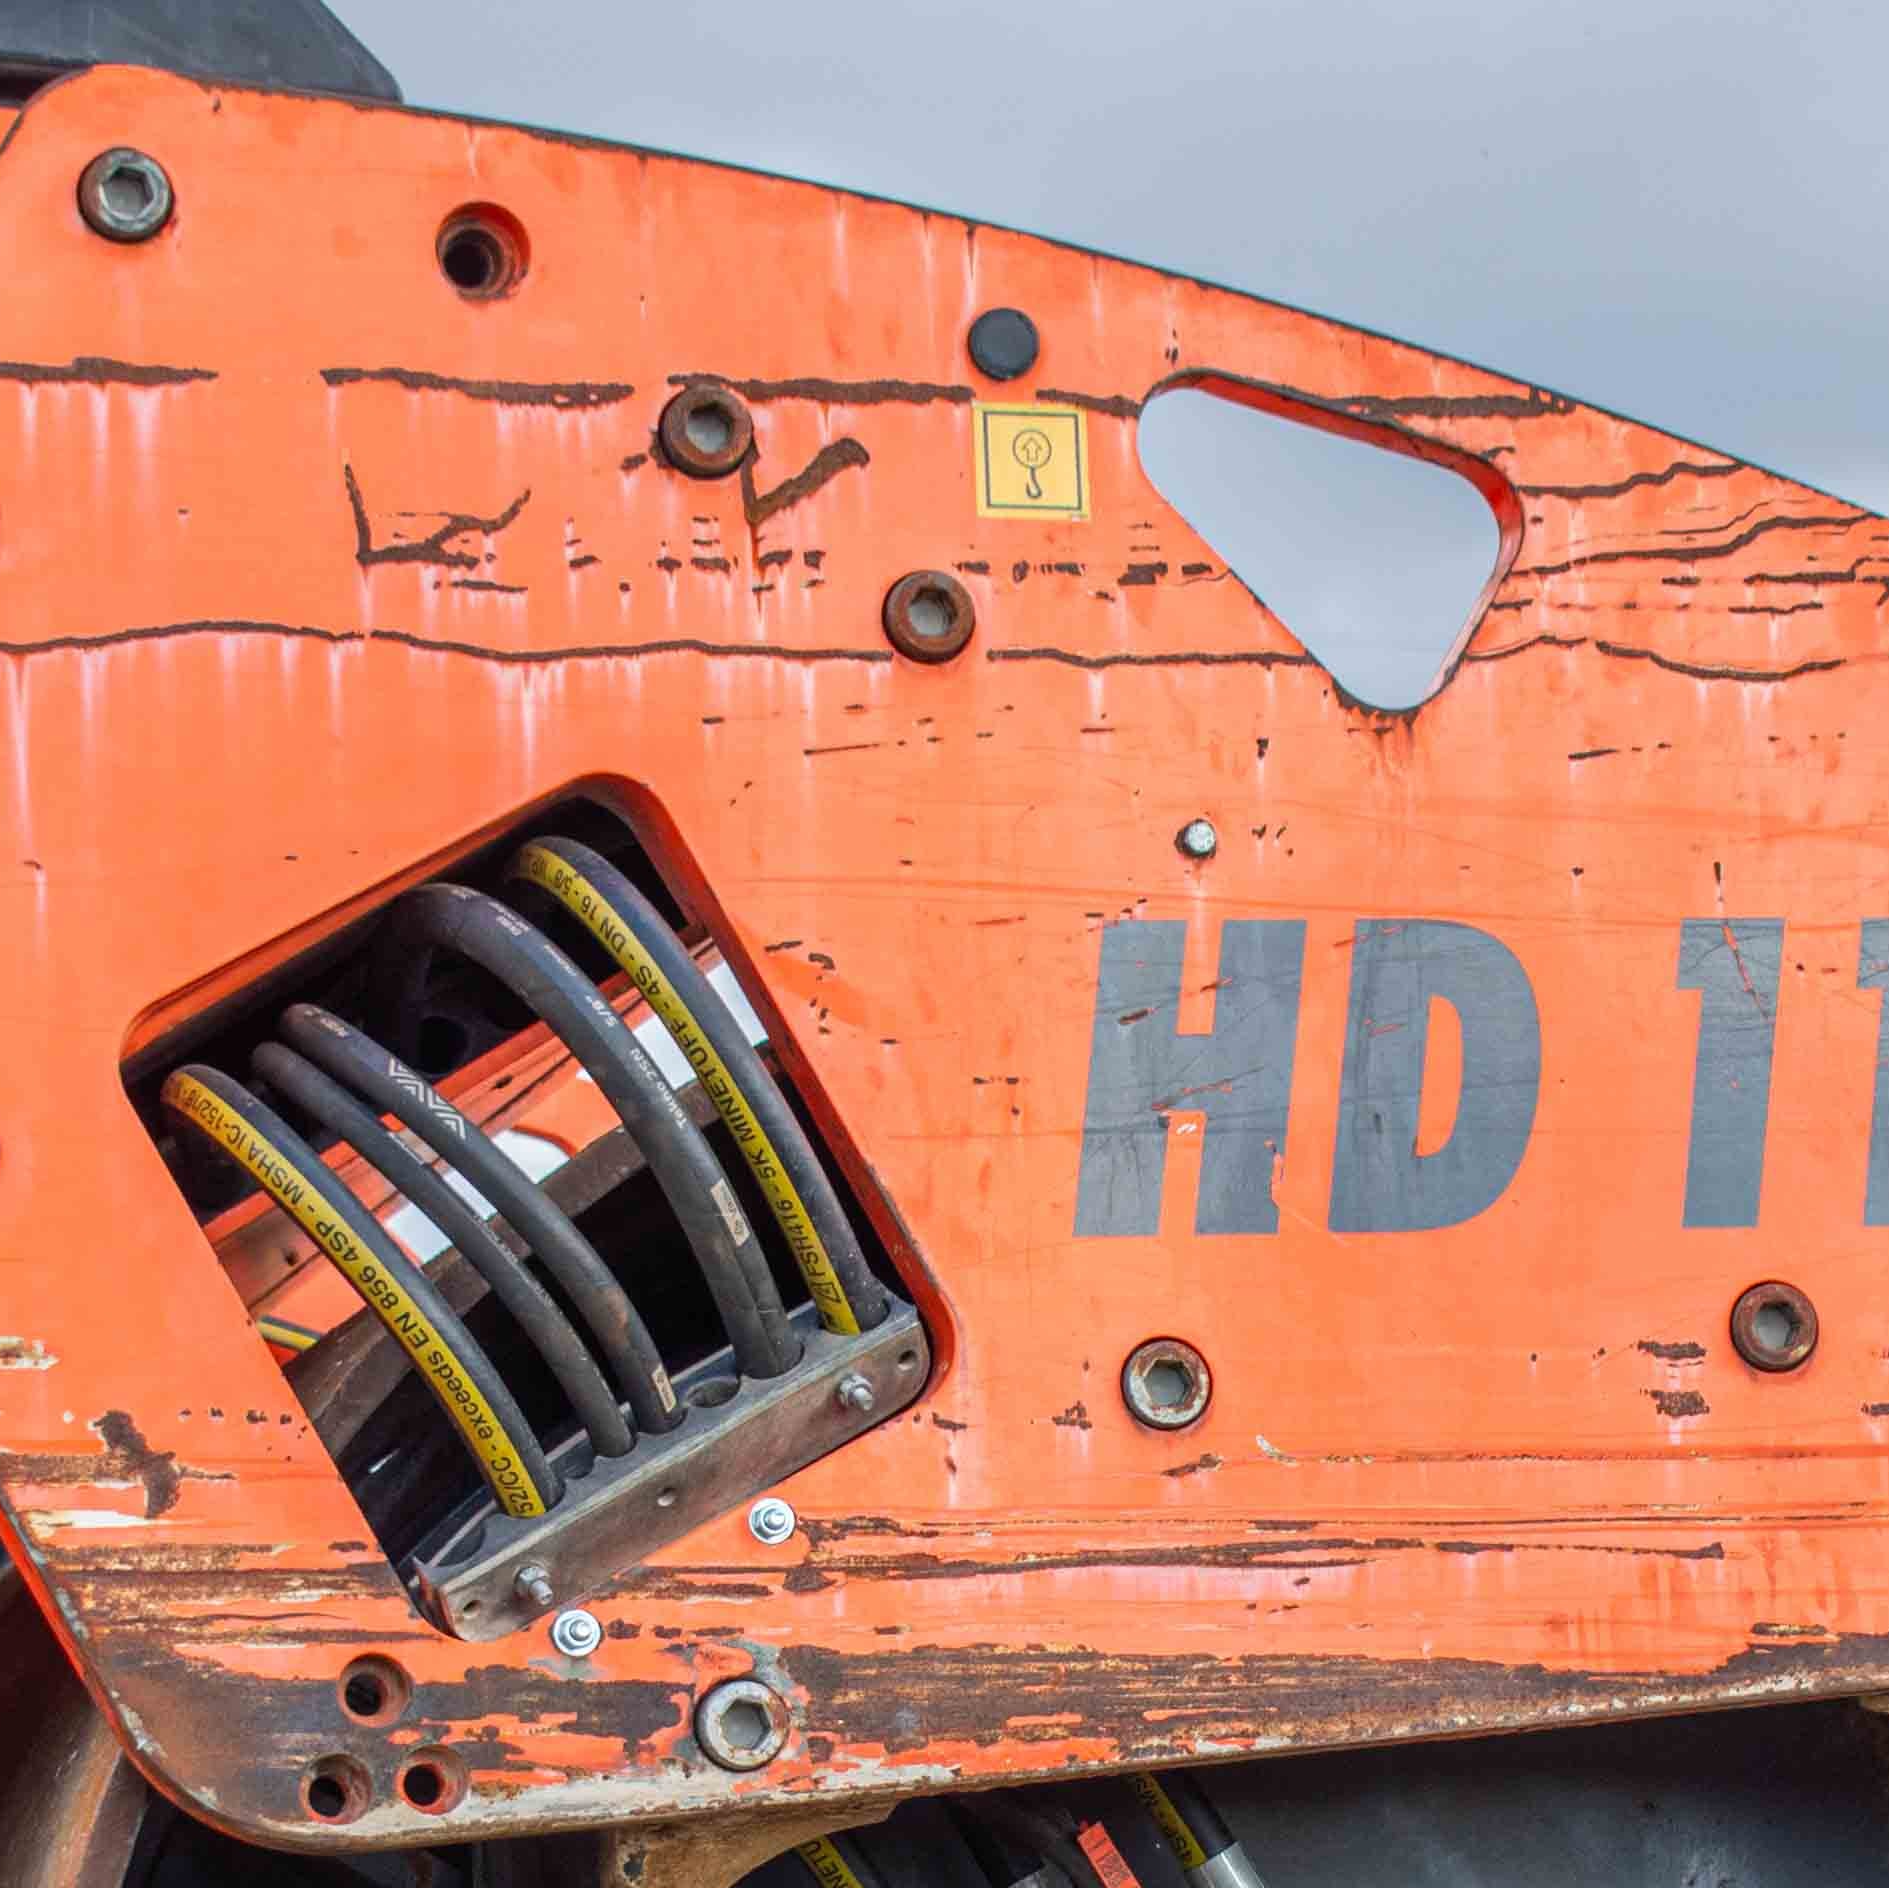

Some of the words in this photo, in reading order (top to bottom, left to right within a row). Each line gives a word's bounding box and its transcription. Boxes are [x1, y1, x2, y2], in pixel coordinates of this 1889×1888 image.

[580, 896, 598, 920] 16
[600, 917, 627, 954] DN
[636, 965, 661, 995] 4S
[670, 1018, 756, 1143] MINETUFF
[1074, 919, 1542, 1236] HD
[247, 1142, 305, 1205] MSHA
[750, 1150, 777, 1181] 5K
[315, 1220, 359, 1263] 4SP
[776, 1199, 826, 1286] FSH416
[359, 1265, 399, 1311] 856
[394, 1311, 430, 1350] EN
[428, 1350, 494, 1441] exceeds
